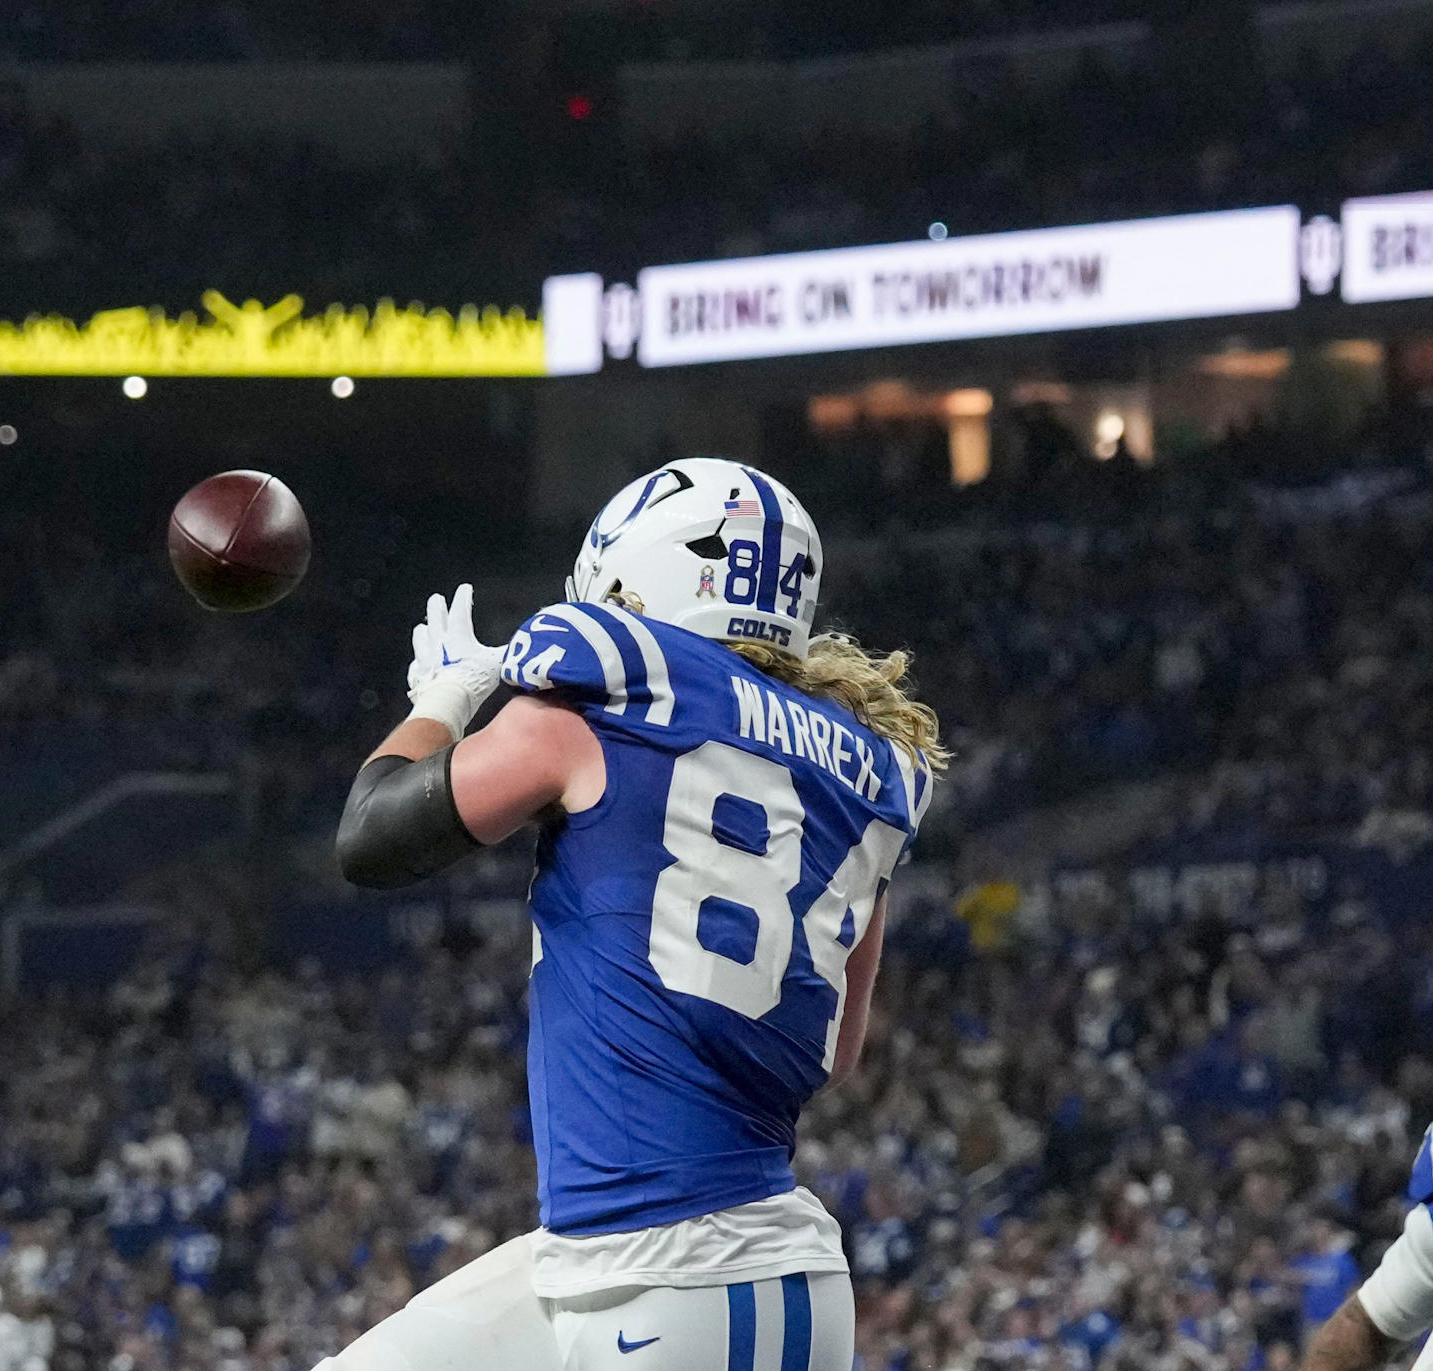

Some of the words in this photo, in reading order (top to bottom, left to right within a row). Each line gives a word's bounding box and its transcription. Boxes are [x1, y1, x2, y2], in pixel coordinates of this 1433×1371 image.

[668, 284, 783, 338] BRING
[800, 277, 854, 322] ON
[871, 252, 1105, 316] TOMORROW
[724, 539, 806, 619] 84
[501, 629, 567, 691] 84
[727, 617, 792, 647] COLTS
[731, 675, 882, 802] WARREN
[649, 740, 909, 1073] 84
